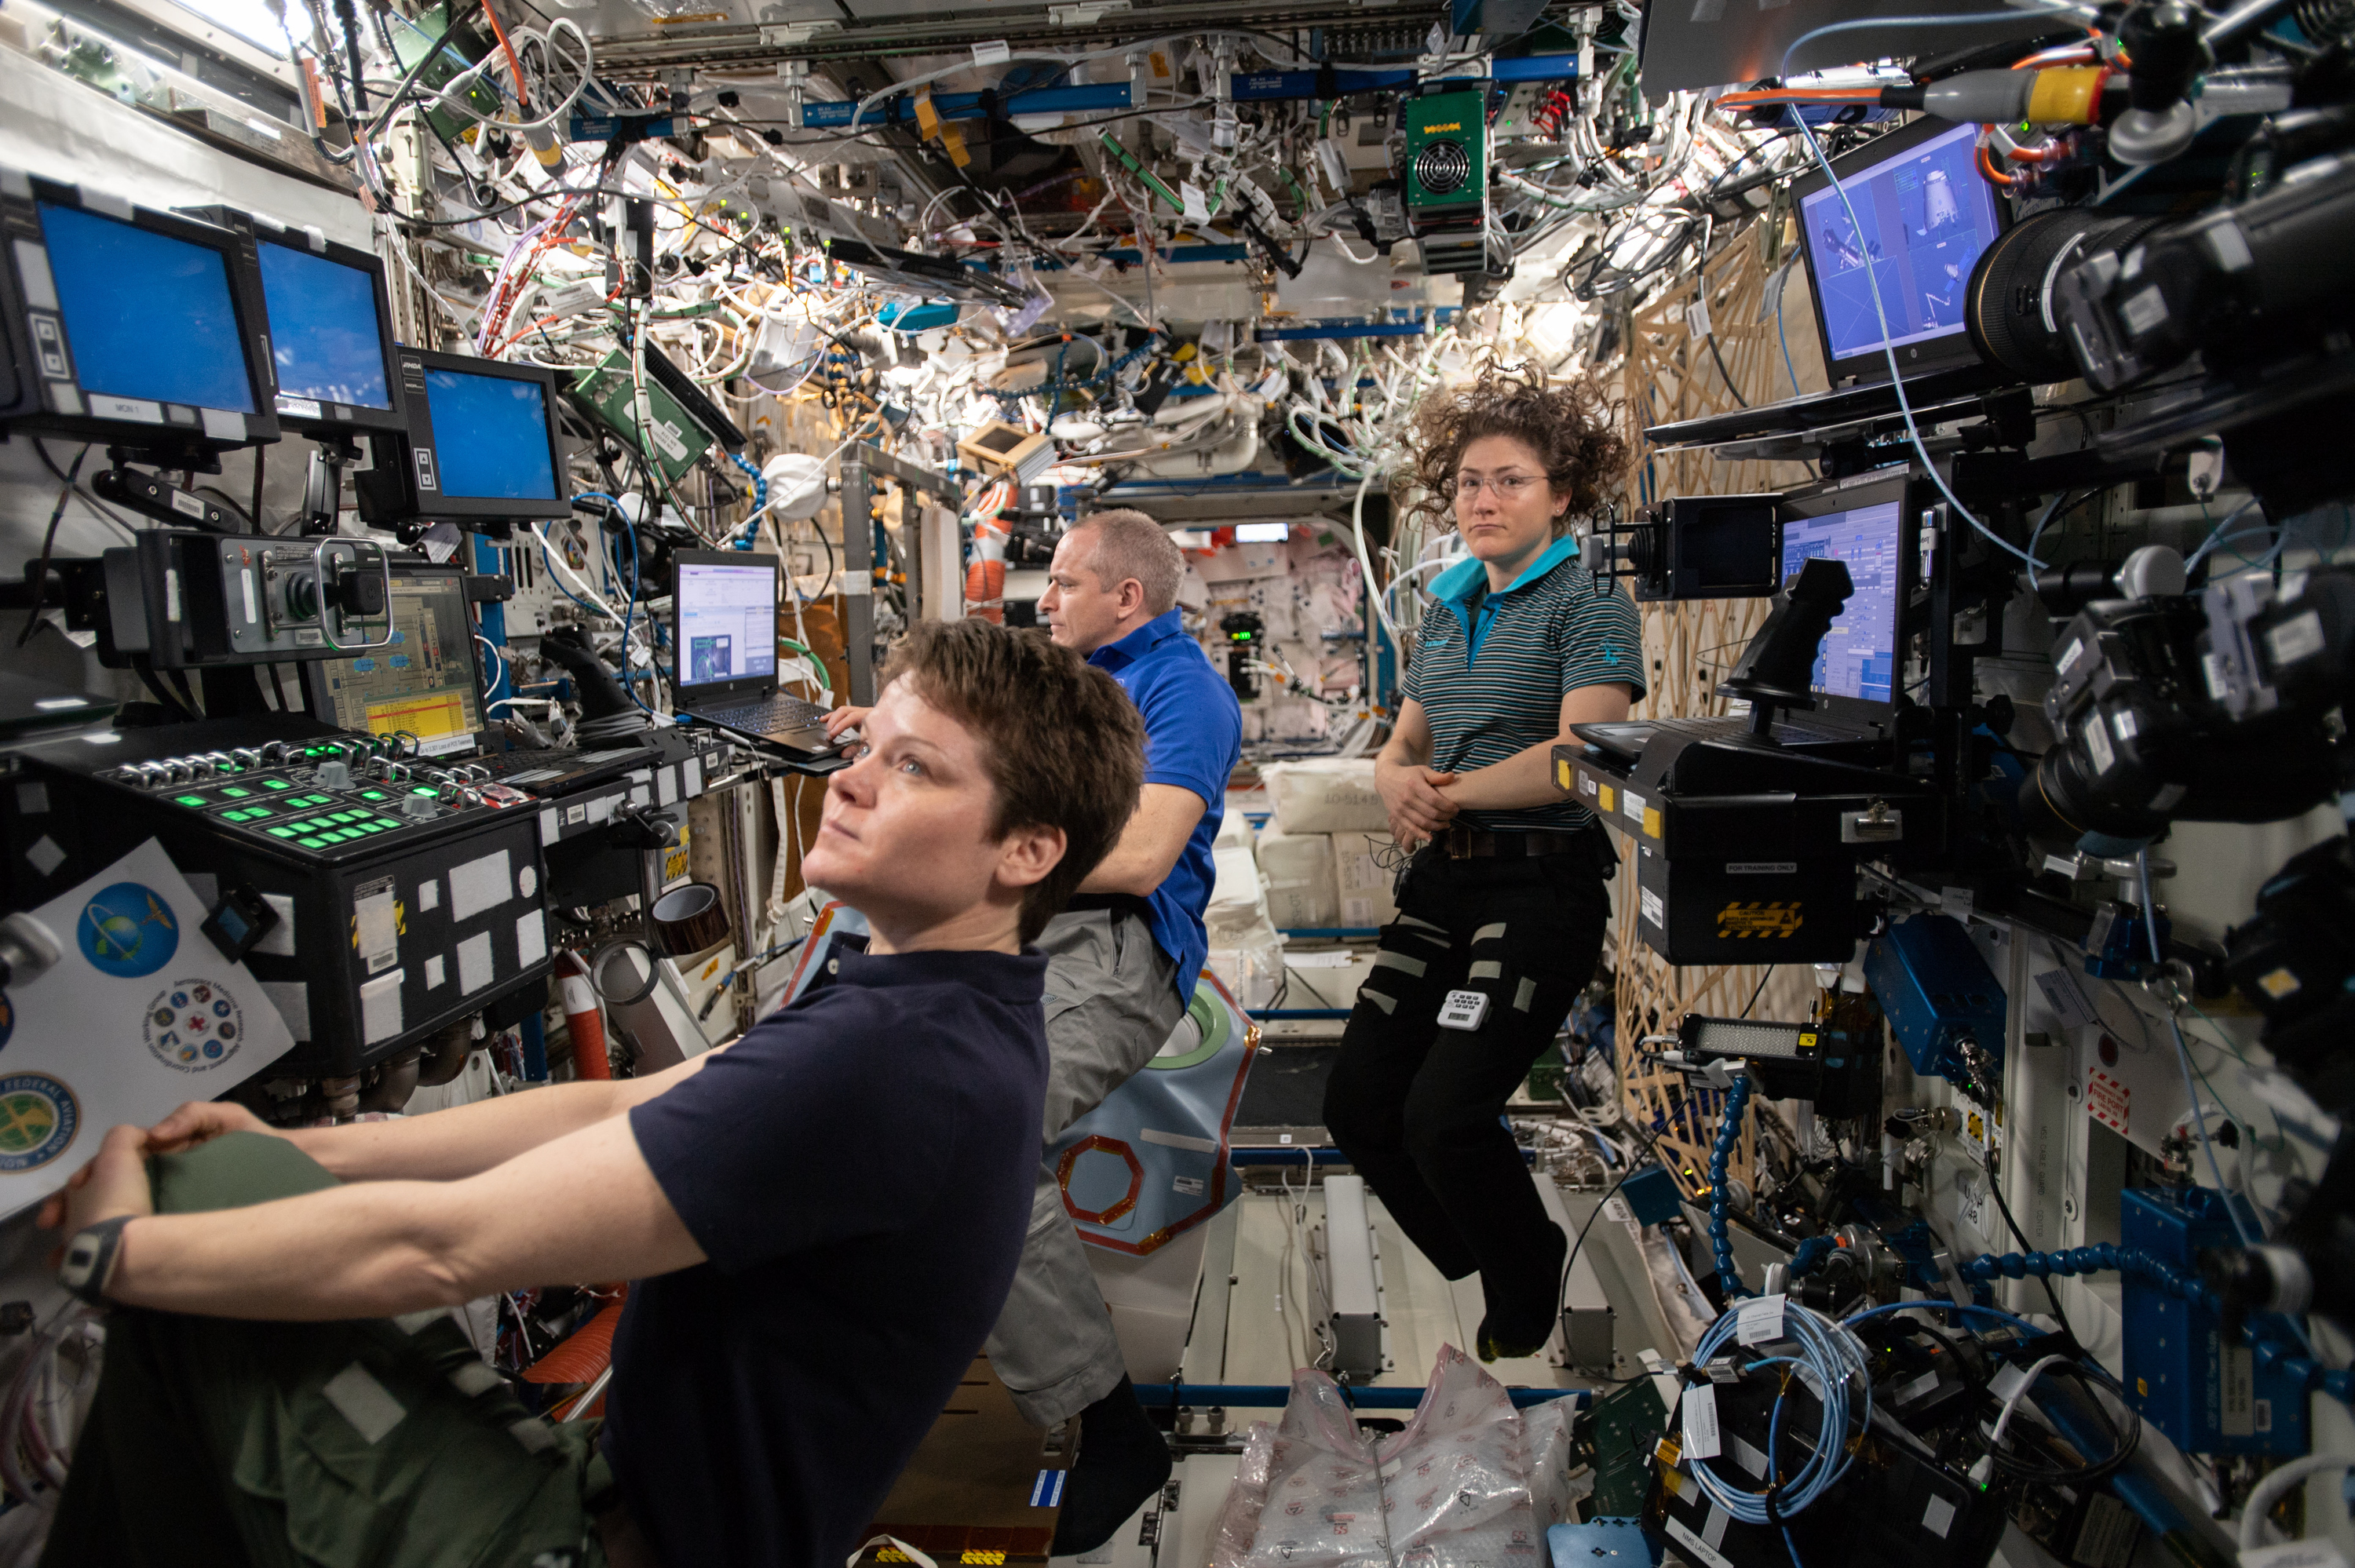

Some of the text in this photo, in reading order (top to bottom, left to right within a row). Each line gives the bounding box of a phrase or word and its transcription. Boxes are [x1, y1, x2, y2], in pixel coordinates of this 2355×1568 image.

[174, 978, 212, 987] Aerospace
[147, 990, 166, 1010] Group
[213, 982, 238, 1009] Medicine
[142, 1011, 153, 1043] Working
[148, 1043, 190, 1074] Coordination
[192, 1065, 207, 1074] and
[2094, 1081, 2116, 1097] EMERGENCY
[2094, 1089, 2123, 1112] FIRE PORT
[4, 1078, 75, 1153] FEDERAL AVIATION
[1681, 1532, 1717, 1564] NMS LAPTOP
